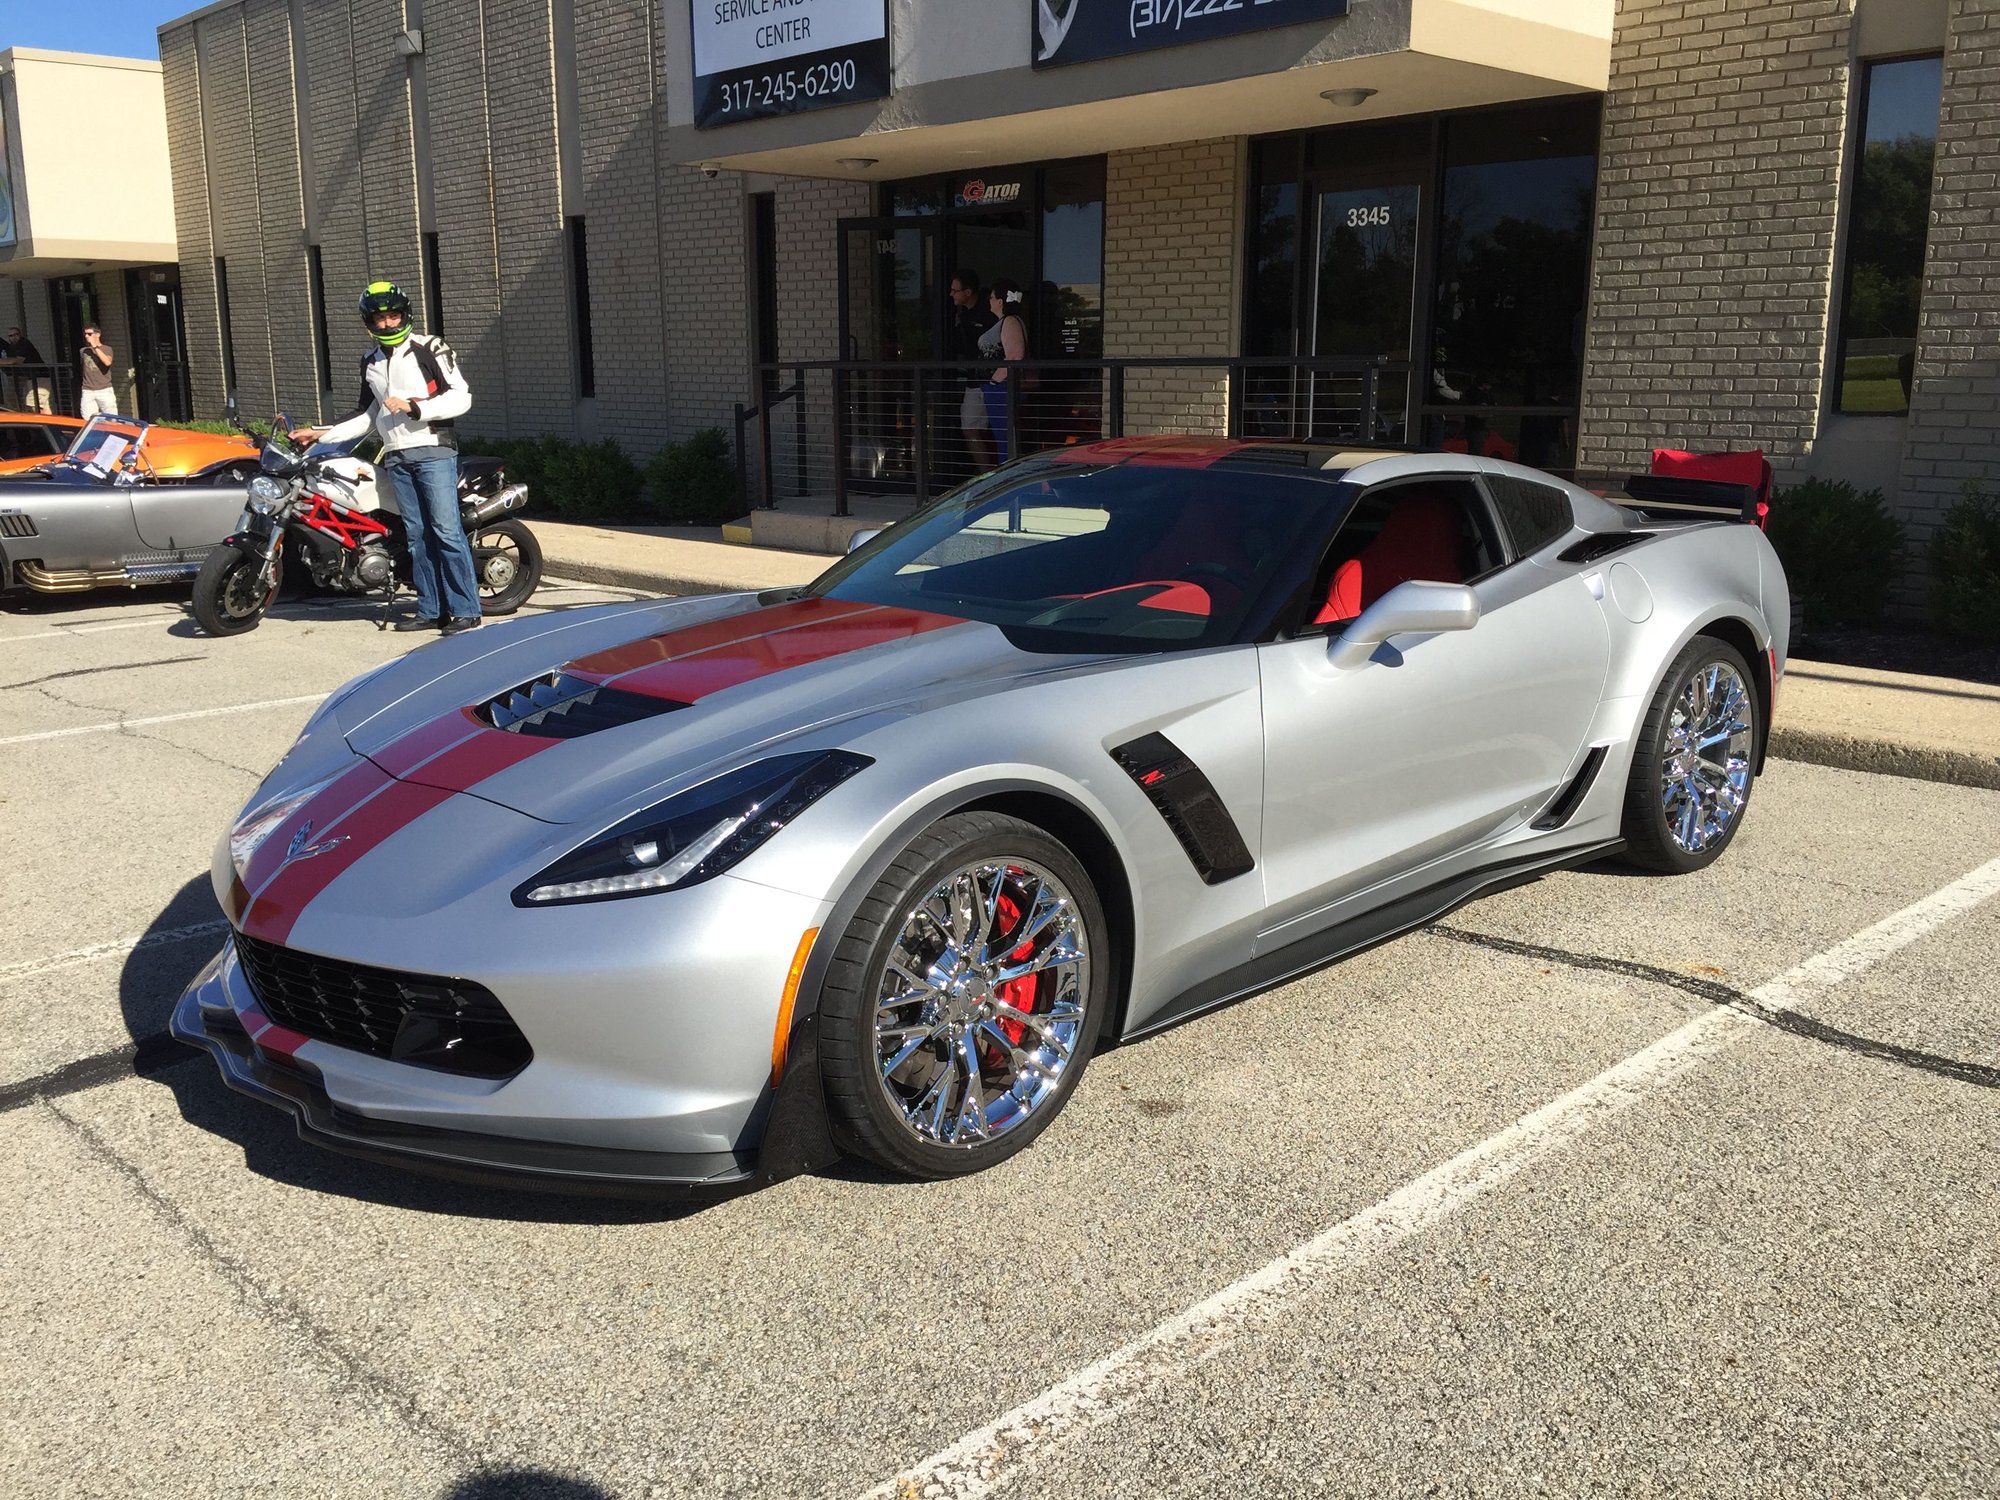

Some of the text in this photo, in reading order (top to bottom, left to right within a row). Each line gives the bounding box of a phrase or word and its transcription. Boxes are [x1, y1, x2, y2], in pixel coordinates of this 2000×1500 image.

[714, 0, 769, 25] SERVICE
[756, 17, 811, 49] CENTER
[721, 59, 856, 113] 317-245-6290
[963, 178, 1021, 202] GATOR
[1347, 206, 1391, 227] 3345
